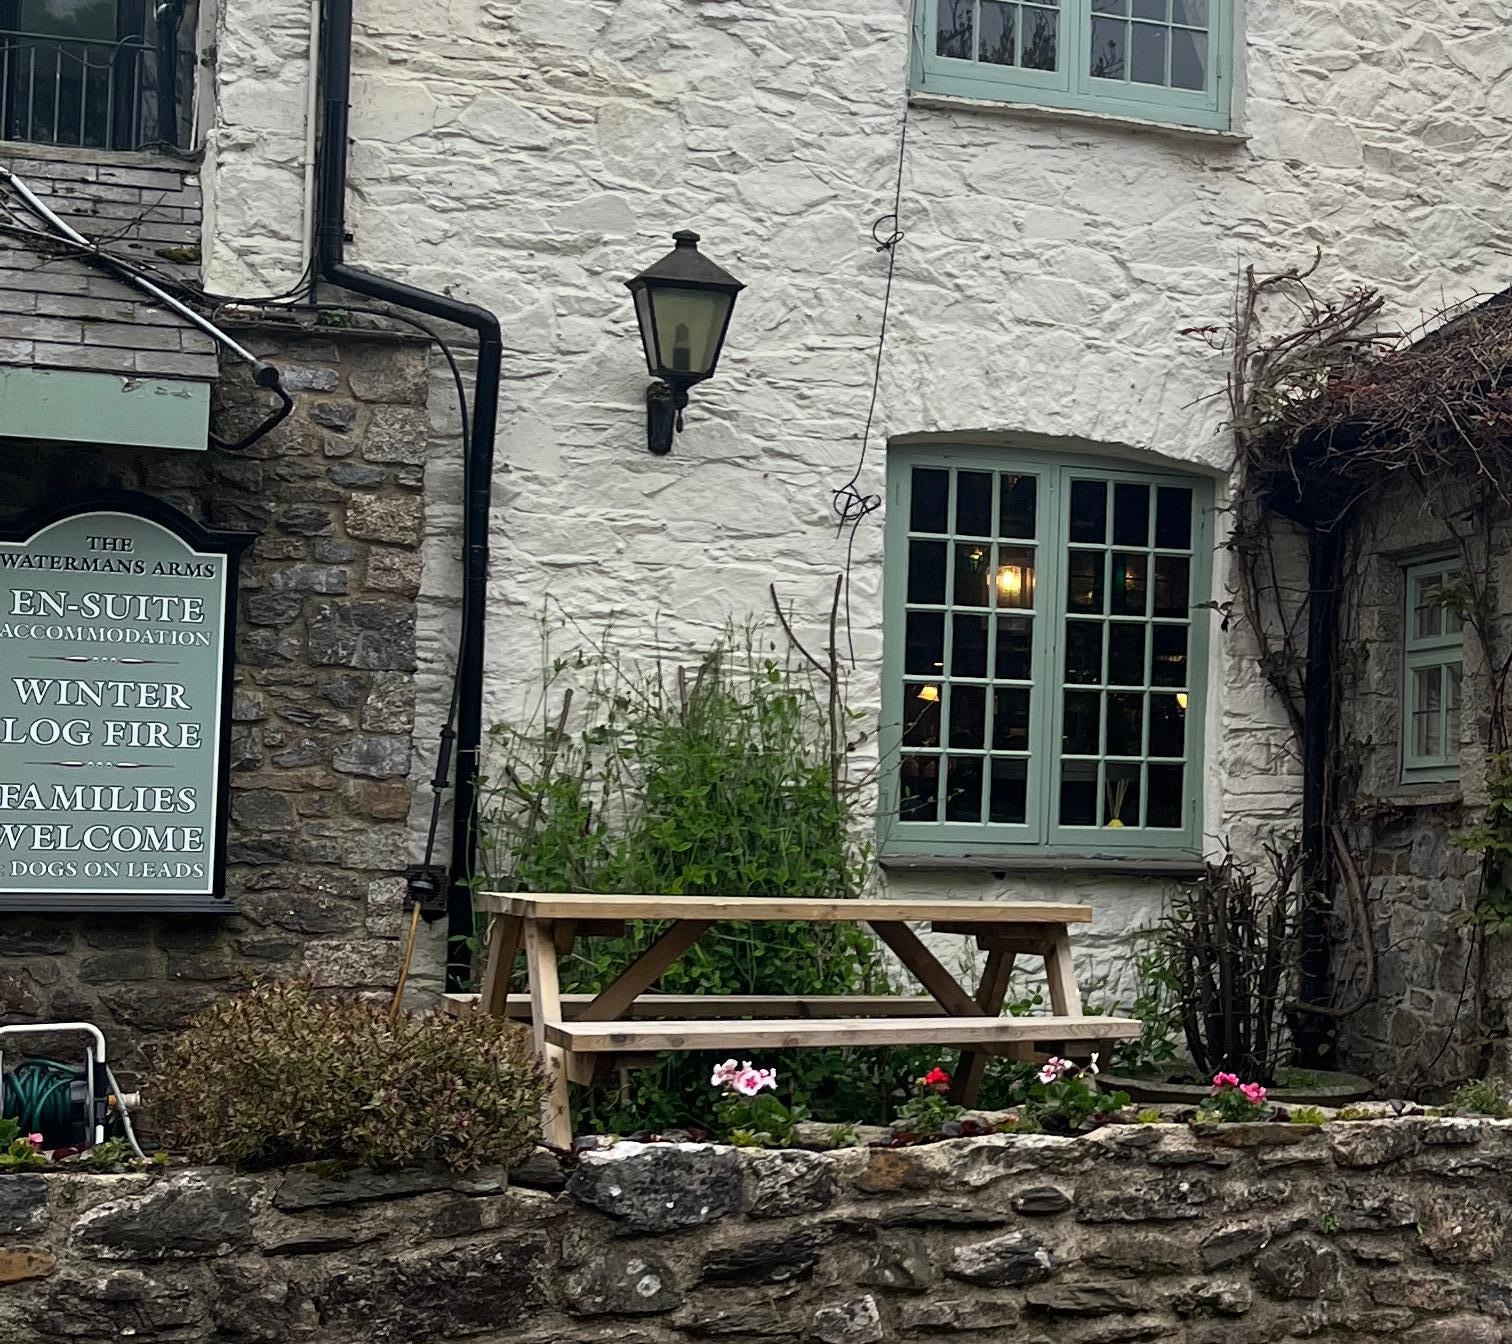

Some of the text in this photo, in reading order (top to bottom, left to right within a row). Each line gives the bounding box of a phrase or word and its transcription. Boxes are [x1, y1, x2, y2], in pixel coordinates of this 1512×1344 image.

[86, 536, 134, 553] THE
[0, 553, 216, 579] WATERMANS ARMS
[9, 588, 205, 623] EN-SUITE
[0, 623, 211, 646] ACCOMMODATION
[12, 676, 192, 711] WINTER
[1, 716, 202, 750] LOG FIRE
[0, 782, 197, 813] FAMILIES
[0, 823, 205, 853] WELCOME
[10, 860, 78, 877] DOGS
[84, 861, 120, 877] ON
[127, 862, 204, 878] LEADS
